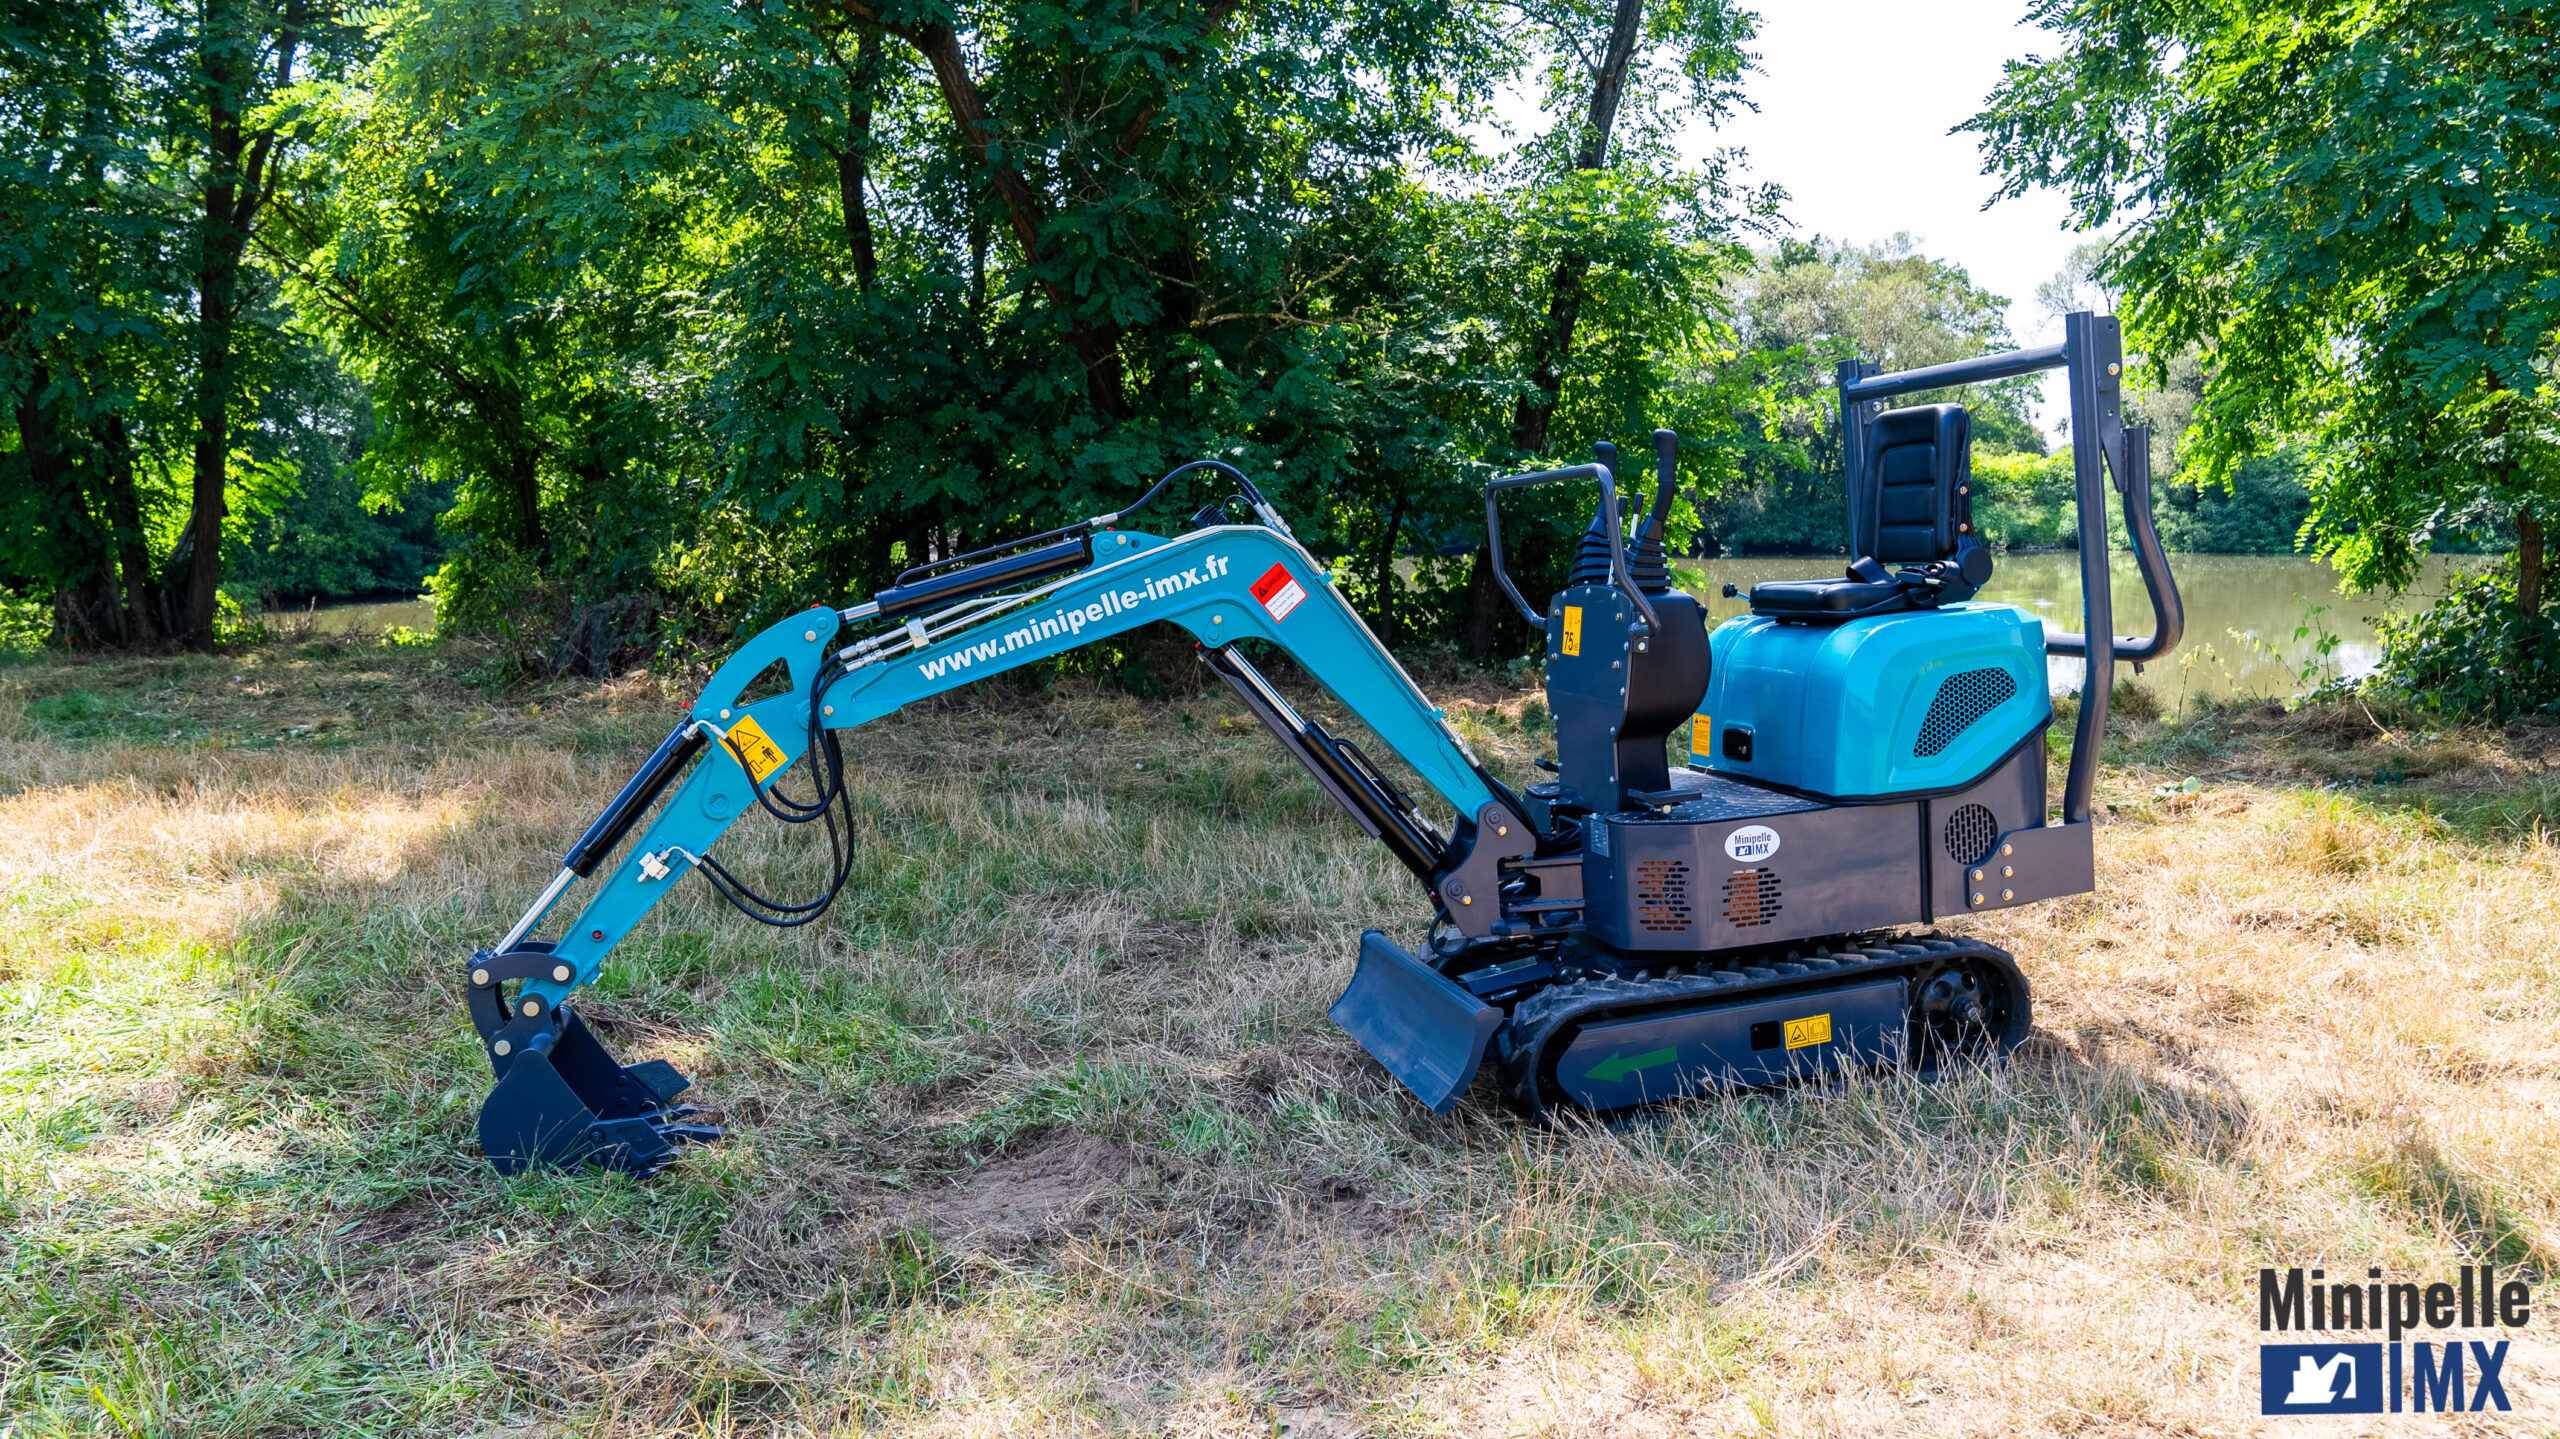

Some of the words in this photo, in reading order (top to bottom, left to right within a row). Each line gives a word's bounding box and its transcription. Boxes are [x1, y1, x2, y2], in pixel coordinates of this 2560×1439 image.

[918, 554, 1230, 681] www.minipelle-imx.fr
[1565, 631, 1574, 651] 75
[1734, 832, 1772, 845] Minipelle
[1752, 843, 1769, 855] IMX
